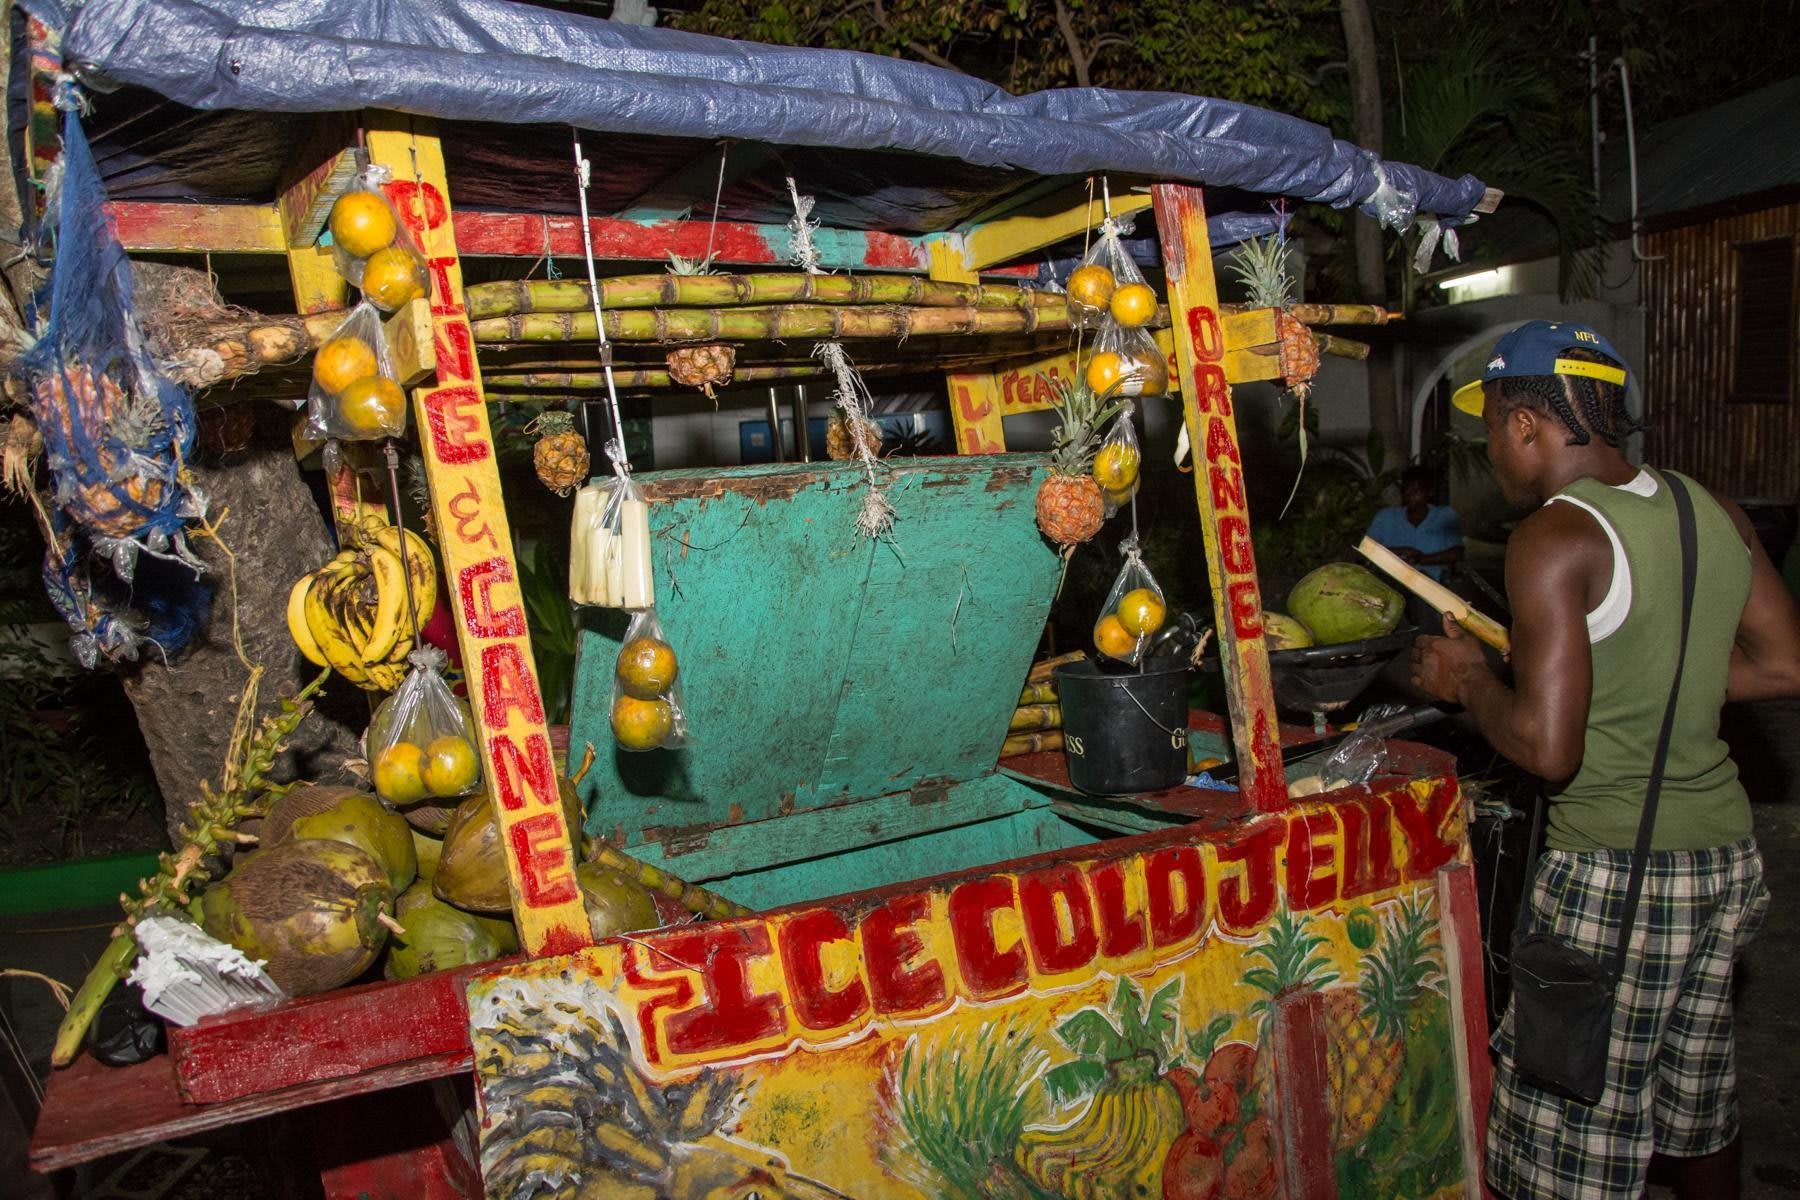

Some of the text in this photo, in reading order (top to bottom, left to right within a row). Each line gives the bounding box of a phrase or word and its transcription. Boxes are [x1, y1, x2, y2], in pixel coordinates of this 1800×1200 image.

[1187, 305, 1263, 641] ORANGE
[1574, 330, 1599, 345] NFL
[382, 180, 490, 466] PINE
[459, 556, 579, 910] CANE
[648, 892, 948, 1056] ICE
[949, 844, 1204, 996] COLD
